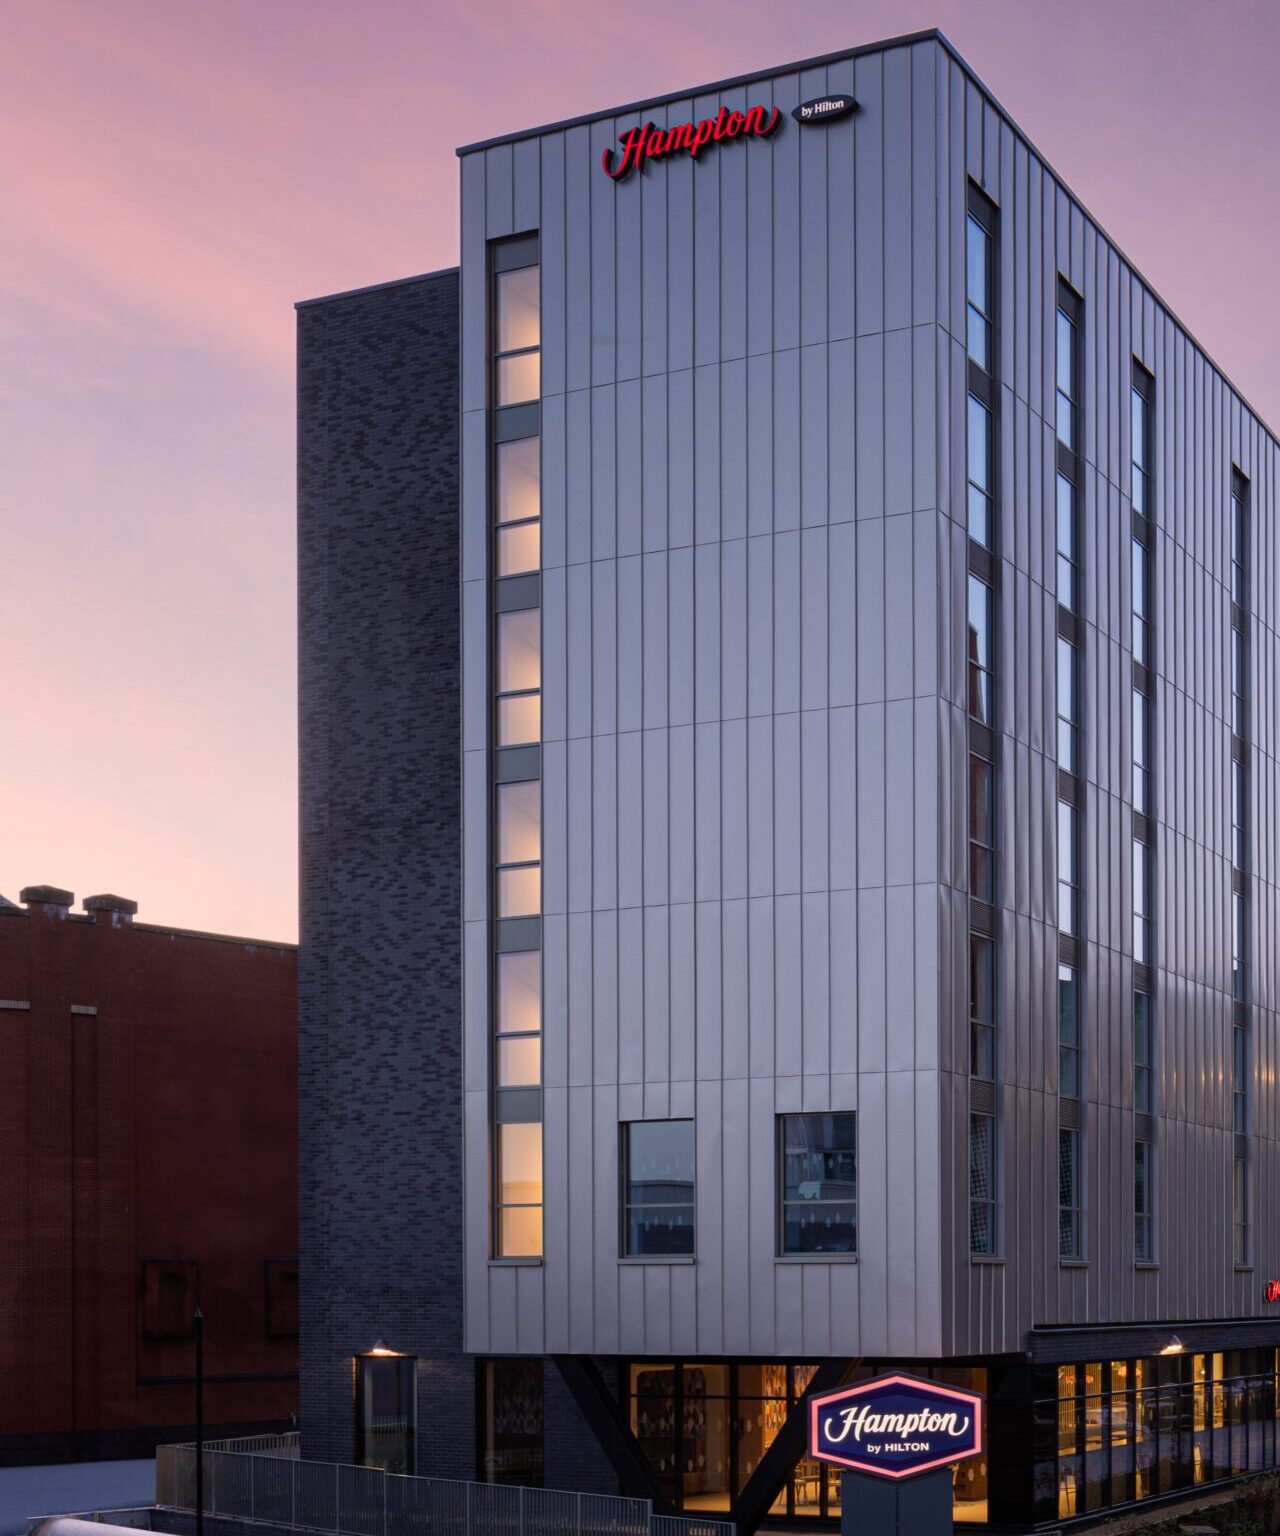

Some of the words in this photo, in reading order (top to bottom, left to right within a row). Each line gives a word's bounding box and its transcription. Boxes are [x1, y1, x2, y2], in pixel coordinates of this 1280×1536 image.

[801, 107, 814, 118] by
[815, 99, 844, 113] Hilton
[602, 105, 780, 177] Hampton
[824, 1405, 969, 1442] Hampton
[867, 1444, 881, 1454] by
[885, 1443, 929, 1451] HILTON
